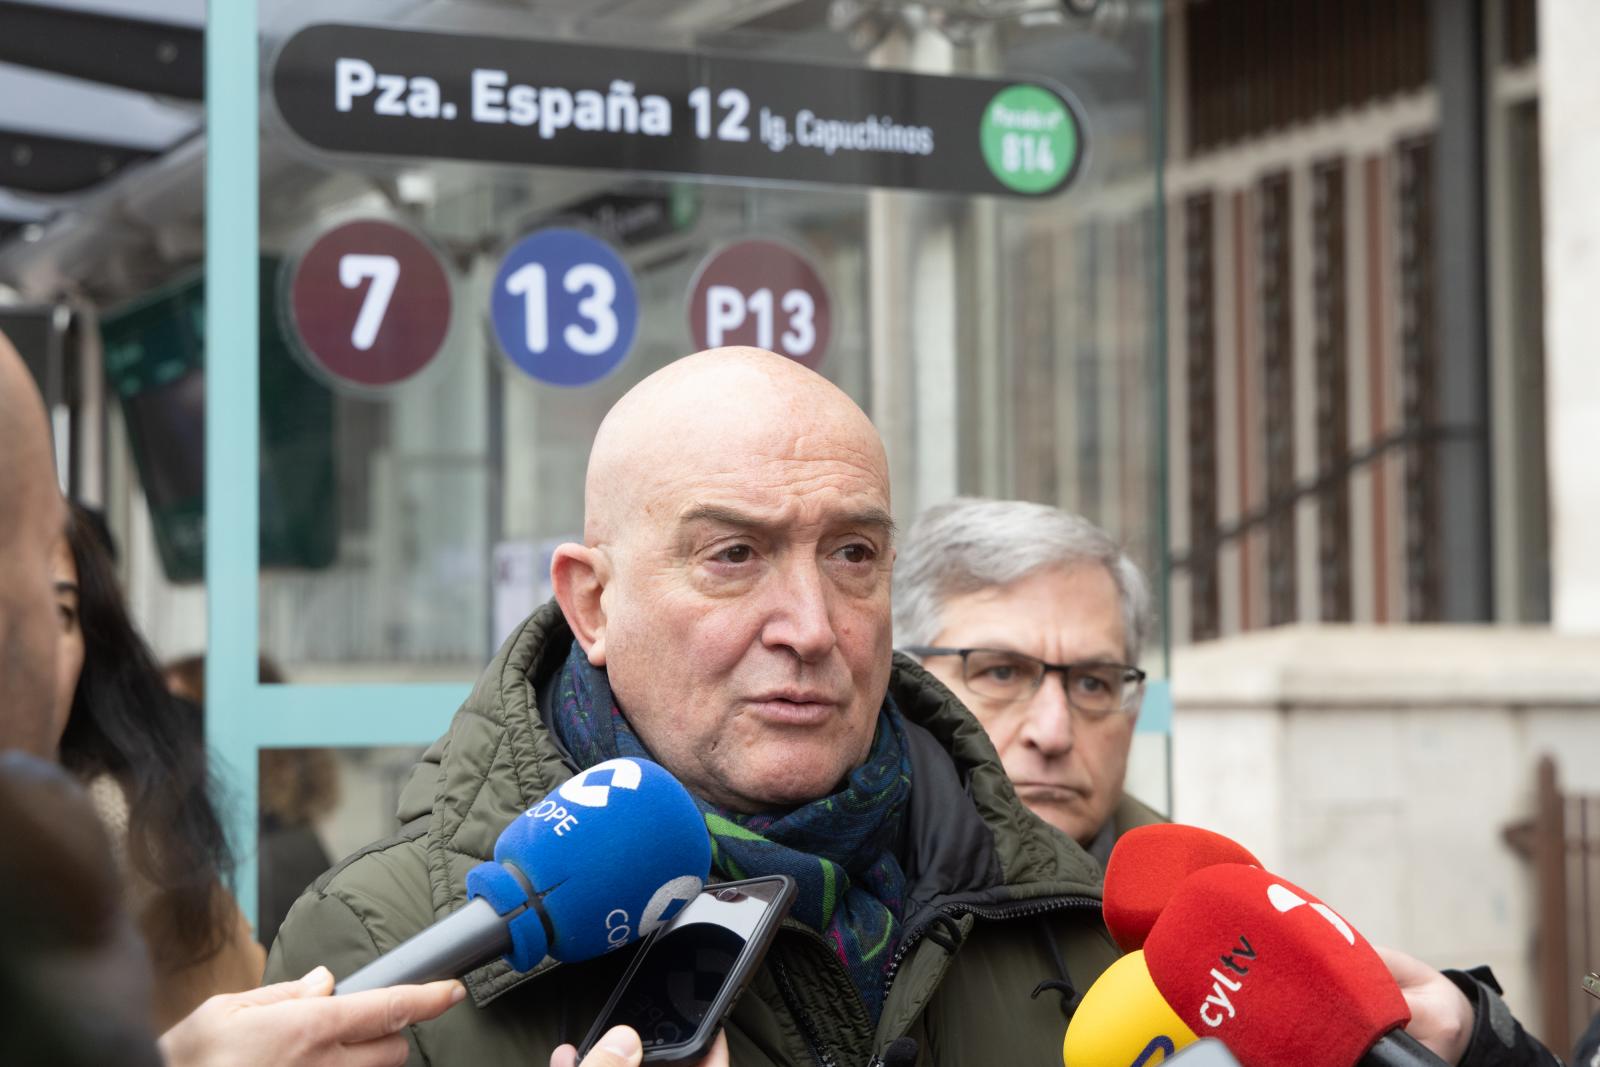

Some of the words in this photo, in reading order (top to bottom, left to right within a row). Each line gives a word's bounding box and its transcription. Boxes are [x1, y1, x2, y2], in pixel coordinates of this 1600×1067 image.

[335, 57, 457, 120] Pza.
[471, 68, 671, 139] España
[688, 86, 750, 142] 12
[795, 109, 935, 156] Capuchinos
[1002, 132, 1056, 174] 814
[339, 254, 400, 350] 7
[506, 262, 619, 355] 13
[705, 285, 816, 356] P13
